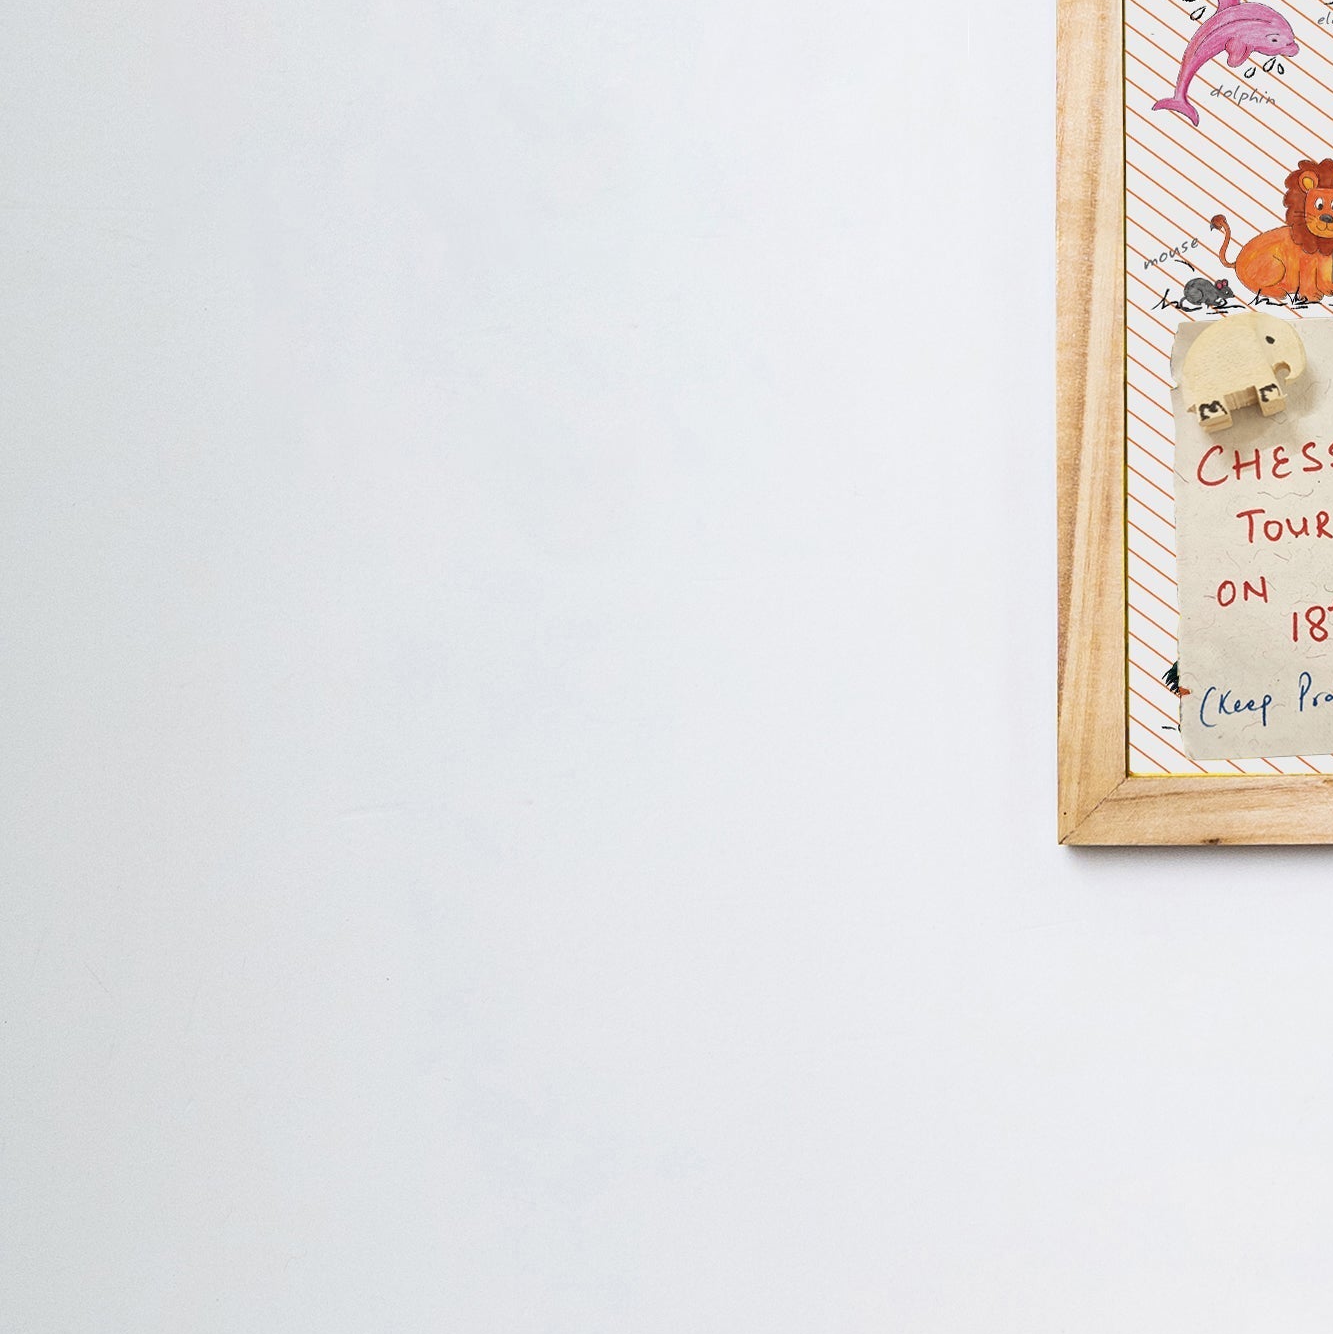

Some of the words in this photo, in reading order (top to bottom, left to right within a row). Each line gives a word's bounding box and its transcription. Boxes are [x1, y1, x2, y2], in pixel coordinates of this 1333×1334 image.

[1210, 85, 1276, 106] dolphin
[1142, 237, 1199, 271] mouse
[1217, 576, 1268, 608] ON
